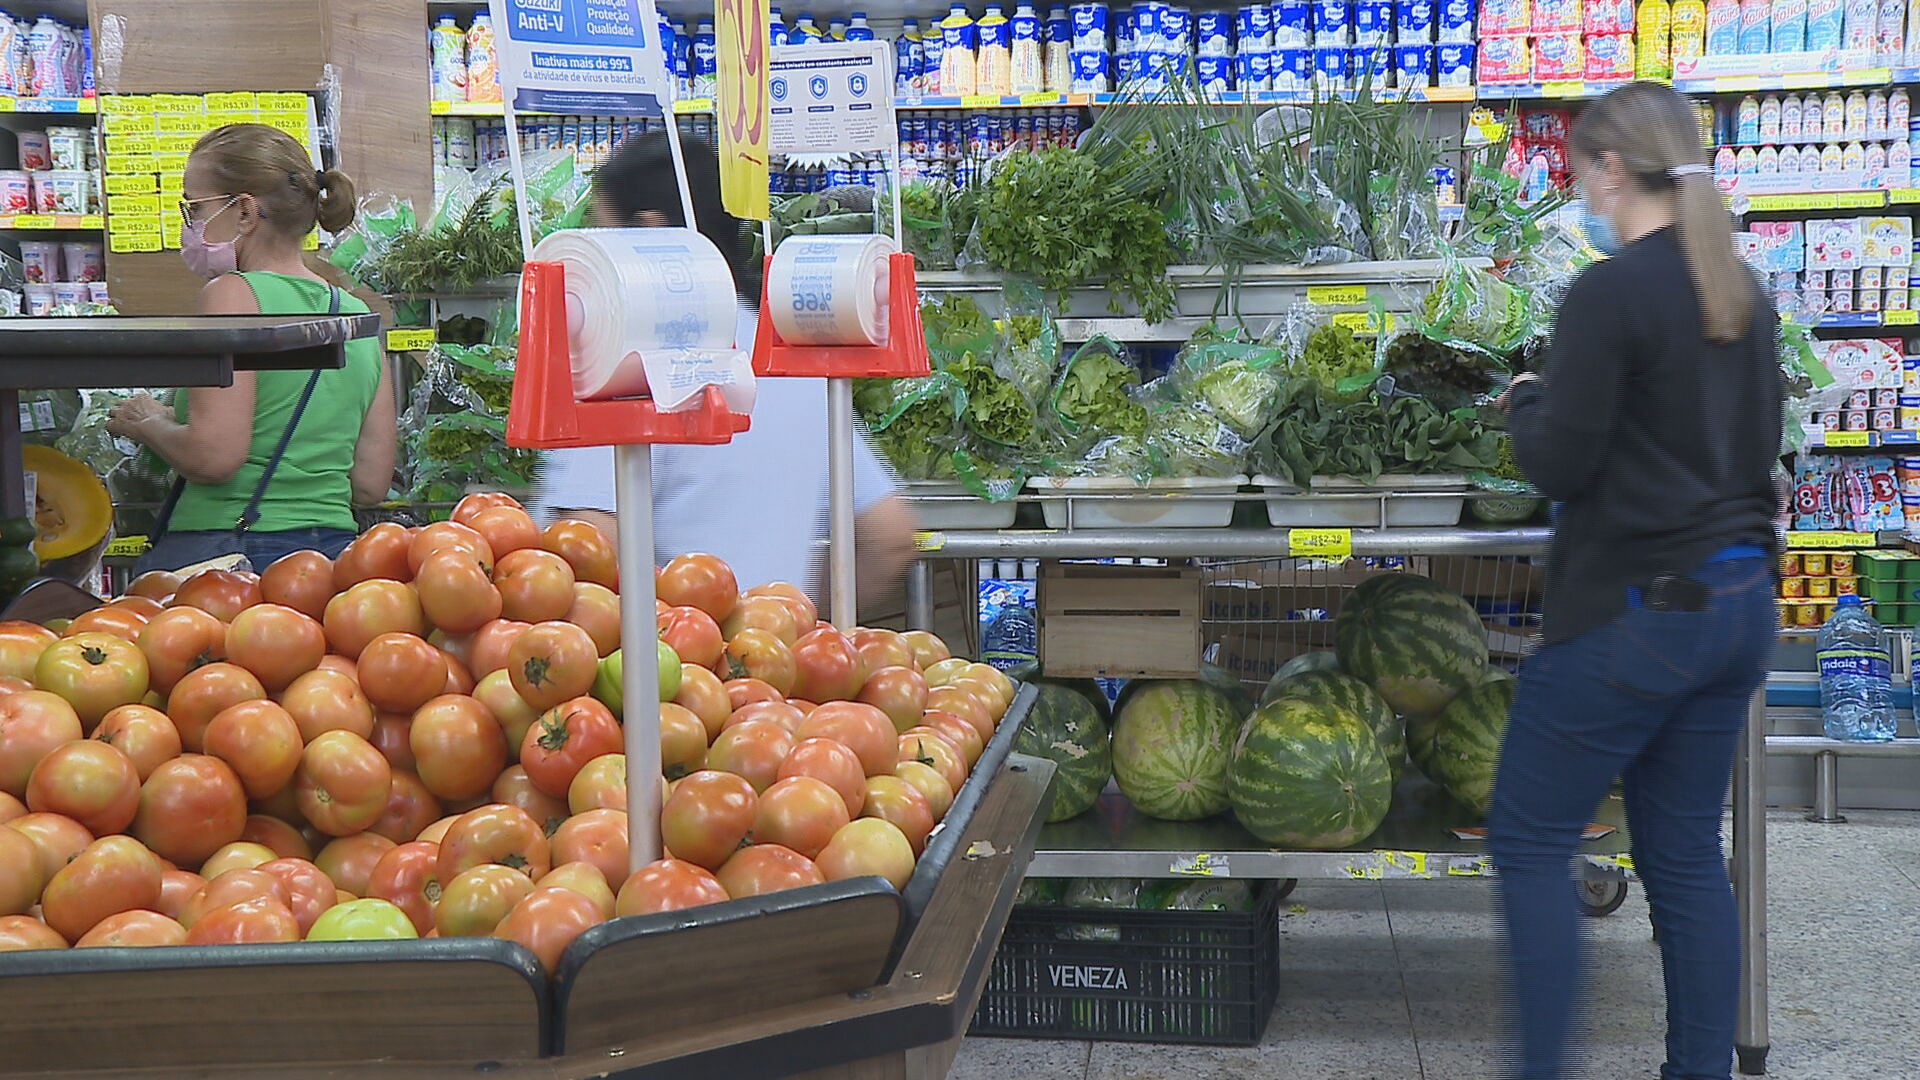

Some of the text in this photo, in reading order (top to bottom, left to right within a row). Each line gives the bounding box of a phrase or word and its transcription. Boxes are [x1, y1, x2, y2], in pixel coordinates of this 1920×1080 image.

[518, 12, 564, 32] Anti-V
[587, 8, 629, 23] Proteção
[586, 22, 634, 36] Qualidade
[535, 54, 631, 71] Inativa mais de 99%
[522, 70, 532, 79] da
[533, 70, 569, 82] atividade
[570, 71, 581, 82] de
[582, 72, 603, 83] vírus
[610, 72, 646, 85] bactérias
[1327, 294, 1358, 303] R$2,59
[1229, 655, 1279, 674] Itamb
[1048, 965, 1129, 990] VENEZA
